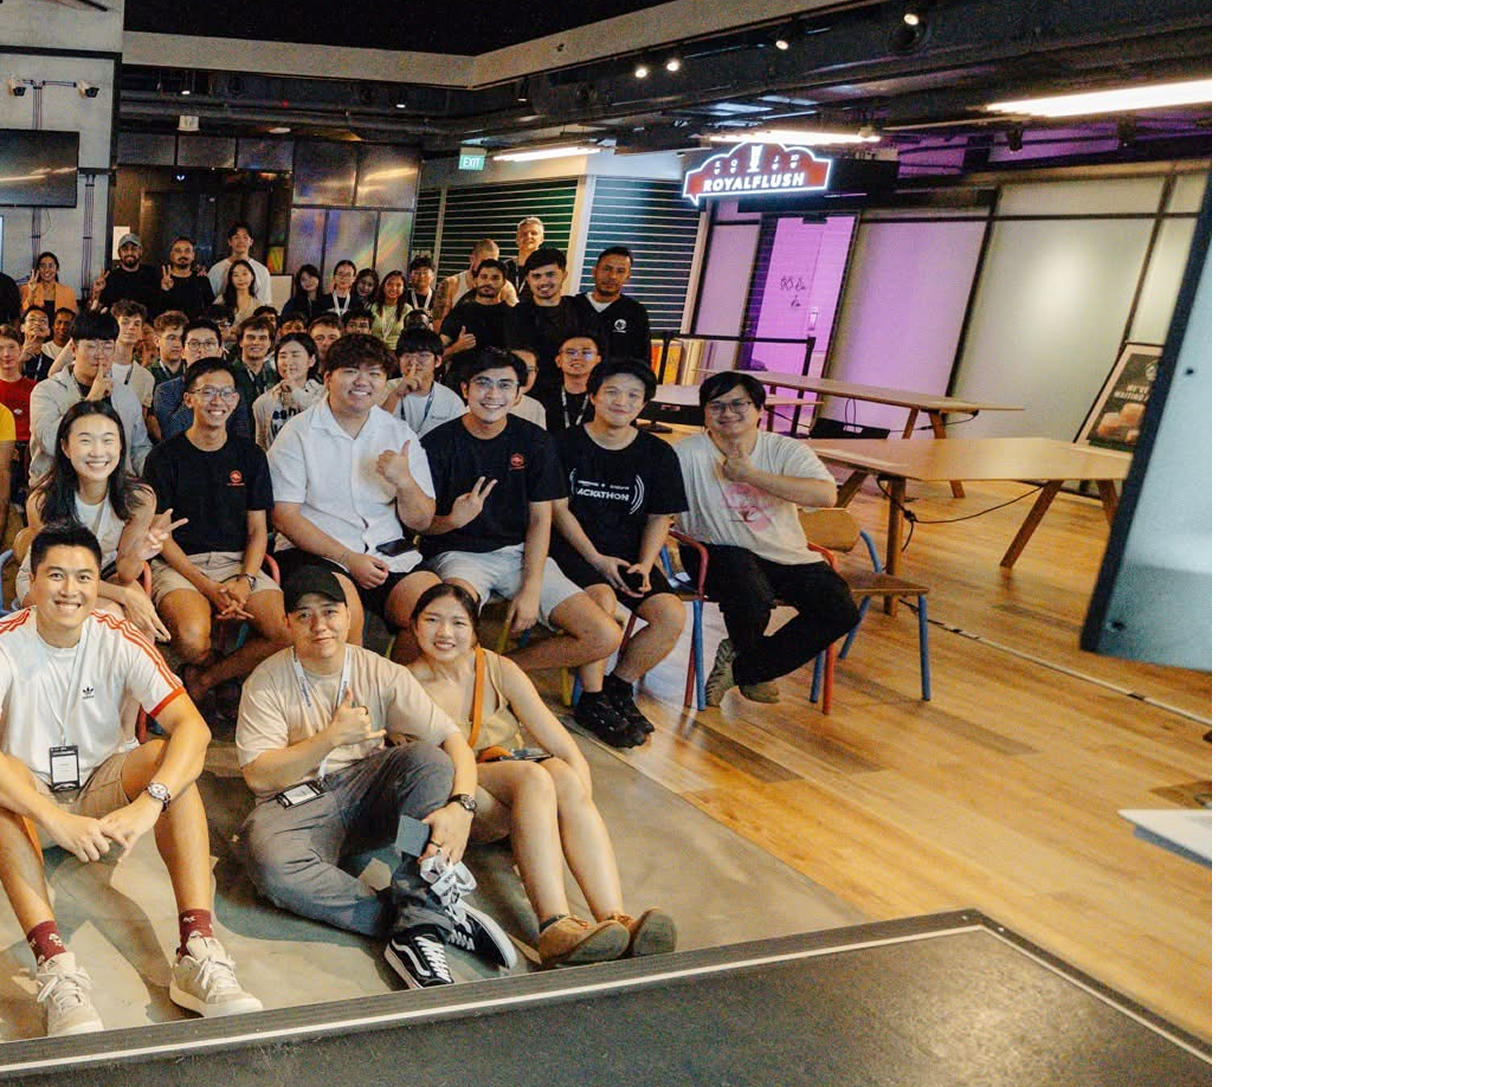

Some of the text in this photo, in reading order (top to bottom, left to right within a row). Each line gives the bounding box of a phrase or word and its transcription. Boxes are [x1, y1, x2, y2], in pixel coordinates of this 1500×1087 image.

[463, 156, 482, 168] EXIT
[703, 172, 806, 193] ROYALFLUSH
[577, 488, 630, 501] ACKATHON
